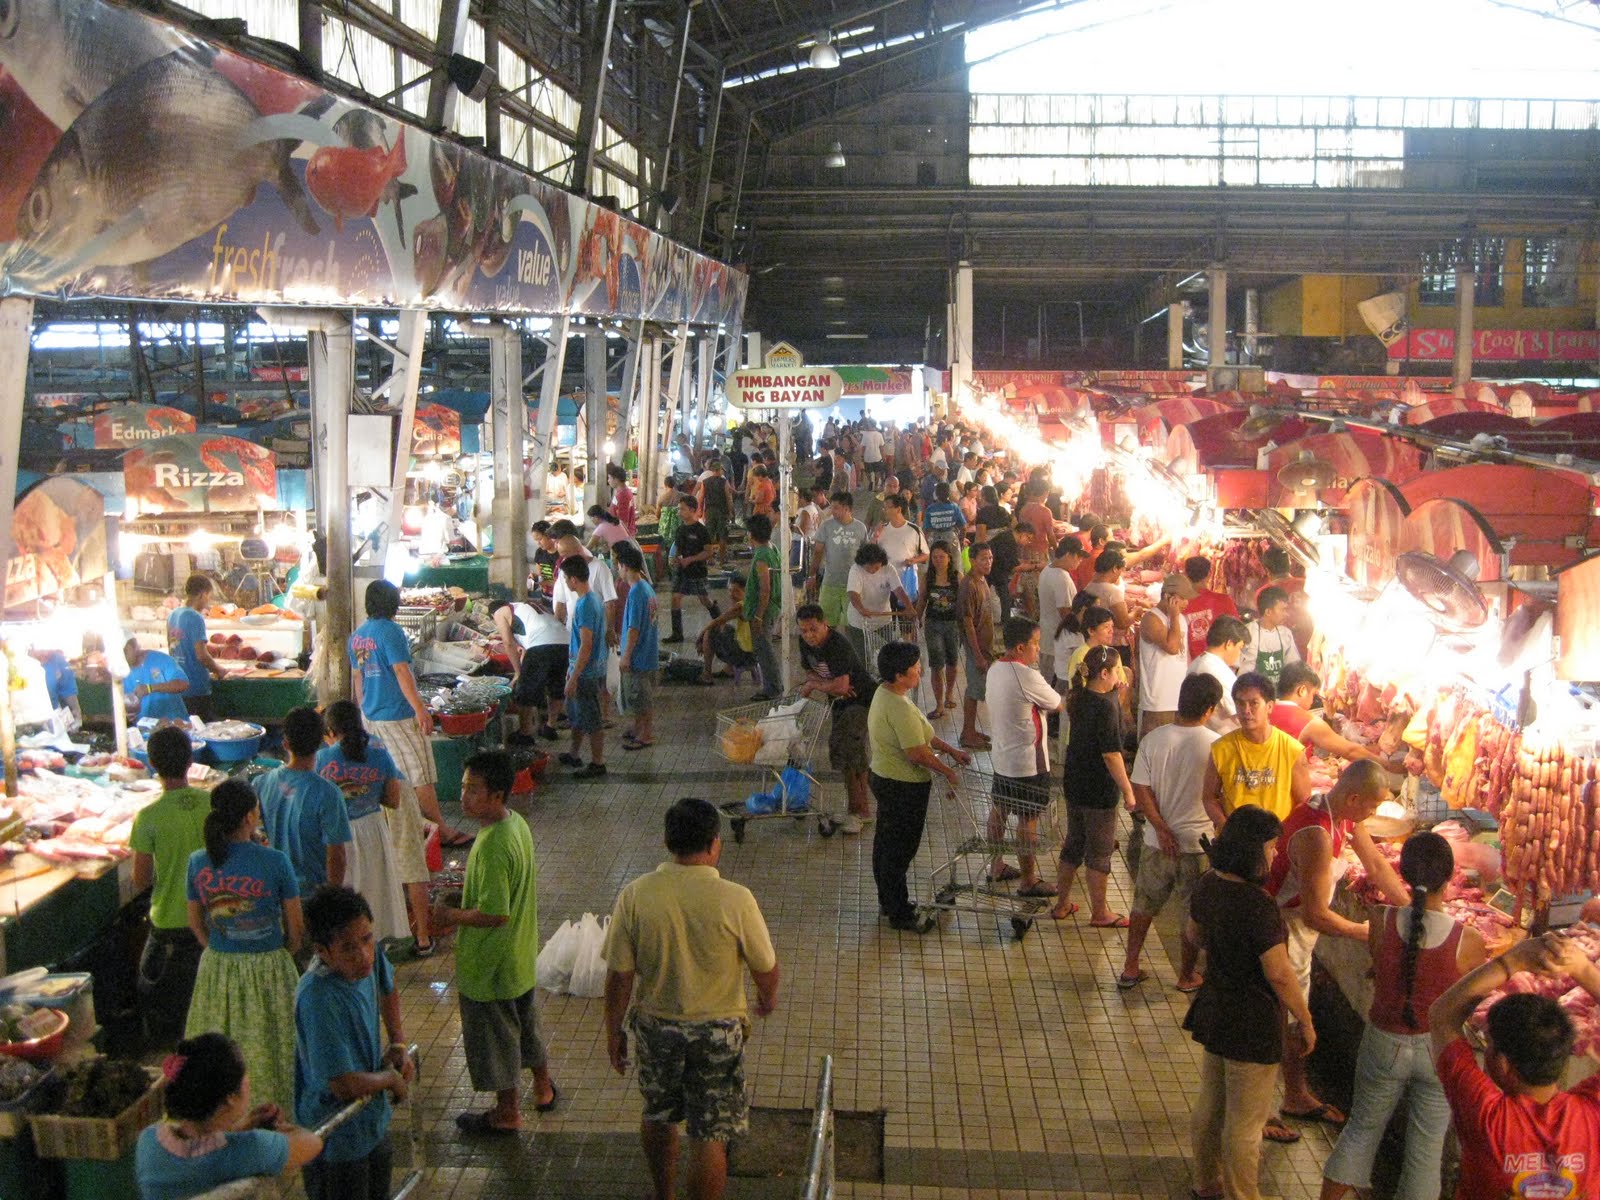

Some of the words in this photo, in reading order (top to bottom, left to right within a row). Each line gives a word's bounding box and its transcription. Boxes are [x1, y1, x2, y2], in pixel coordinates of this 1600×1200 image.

[210, 224, 277, 292] fresh
[517, 239, 551, 287] value
[1480, 330, 1526, 357] Cook
[1531, 332, 1544, 353] &
[736, 374, 831, 388] TIMBANGAN
[862, 379, 908, 391] Market
[742, 391, 765, 403] NG
[770, 390, 825, 402] BAYAN
[111, 422, 177, 442] Edmark
[154, 463, 245, 488] Rizza
[320, 761, 379, 785] Rizza
[195, 866, 265, 905] Rizza
